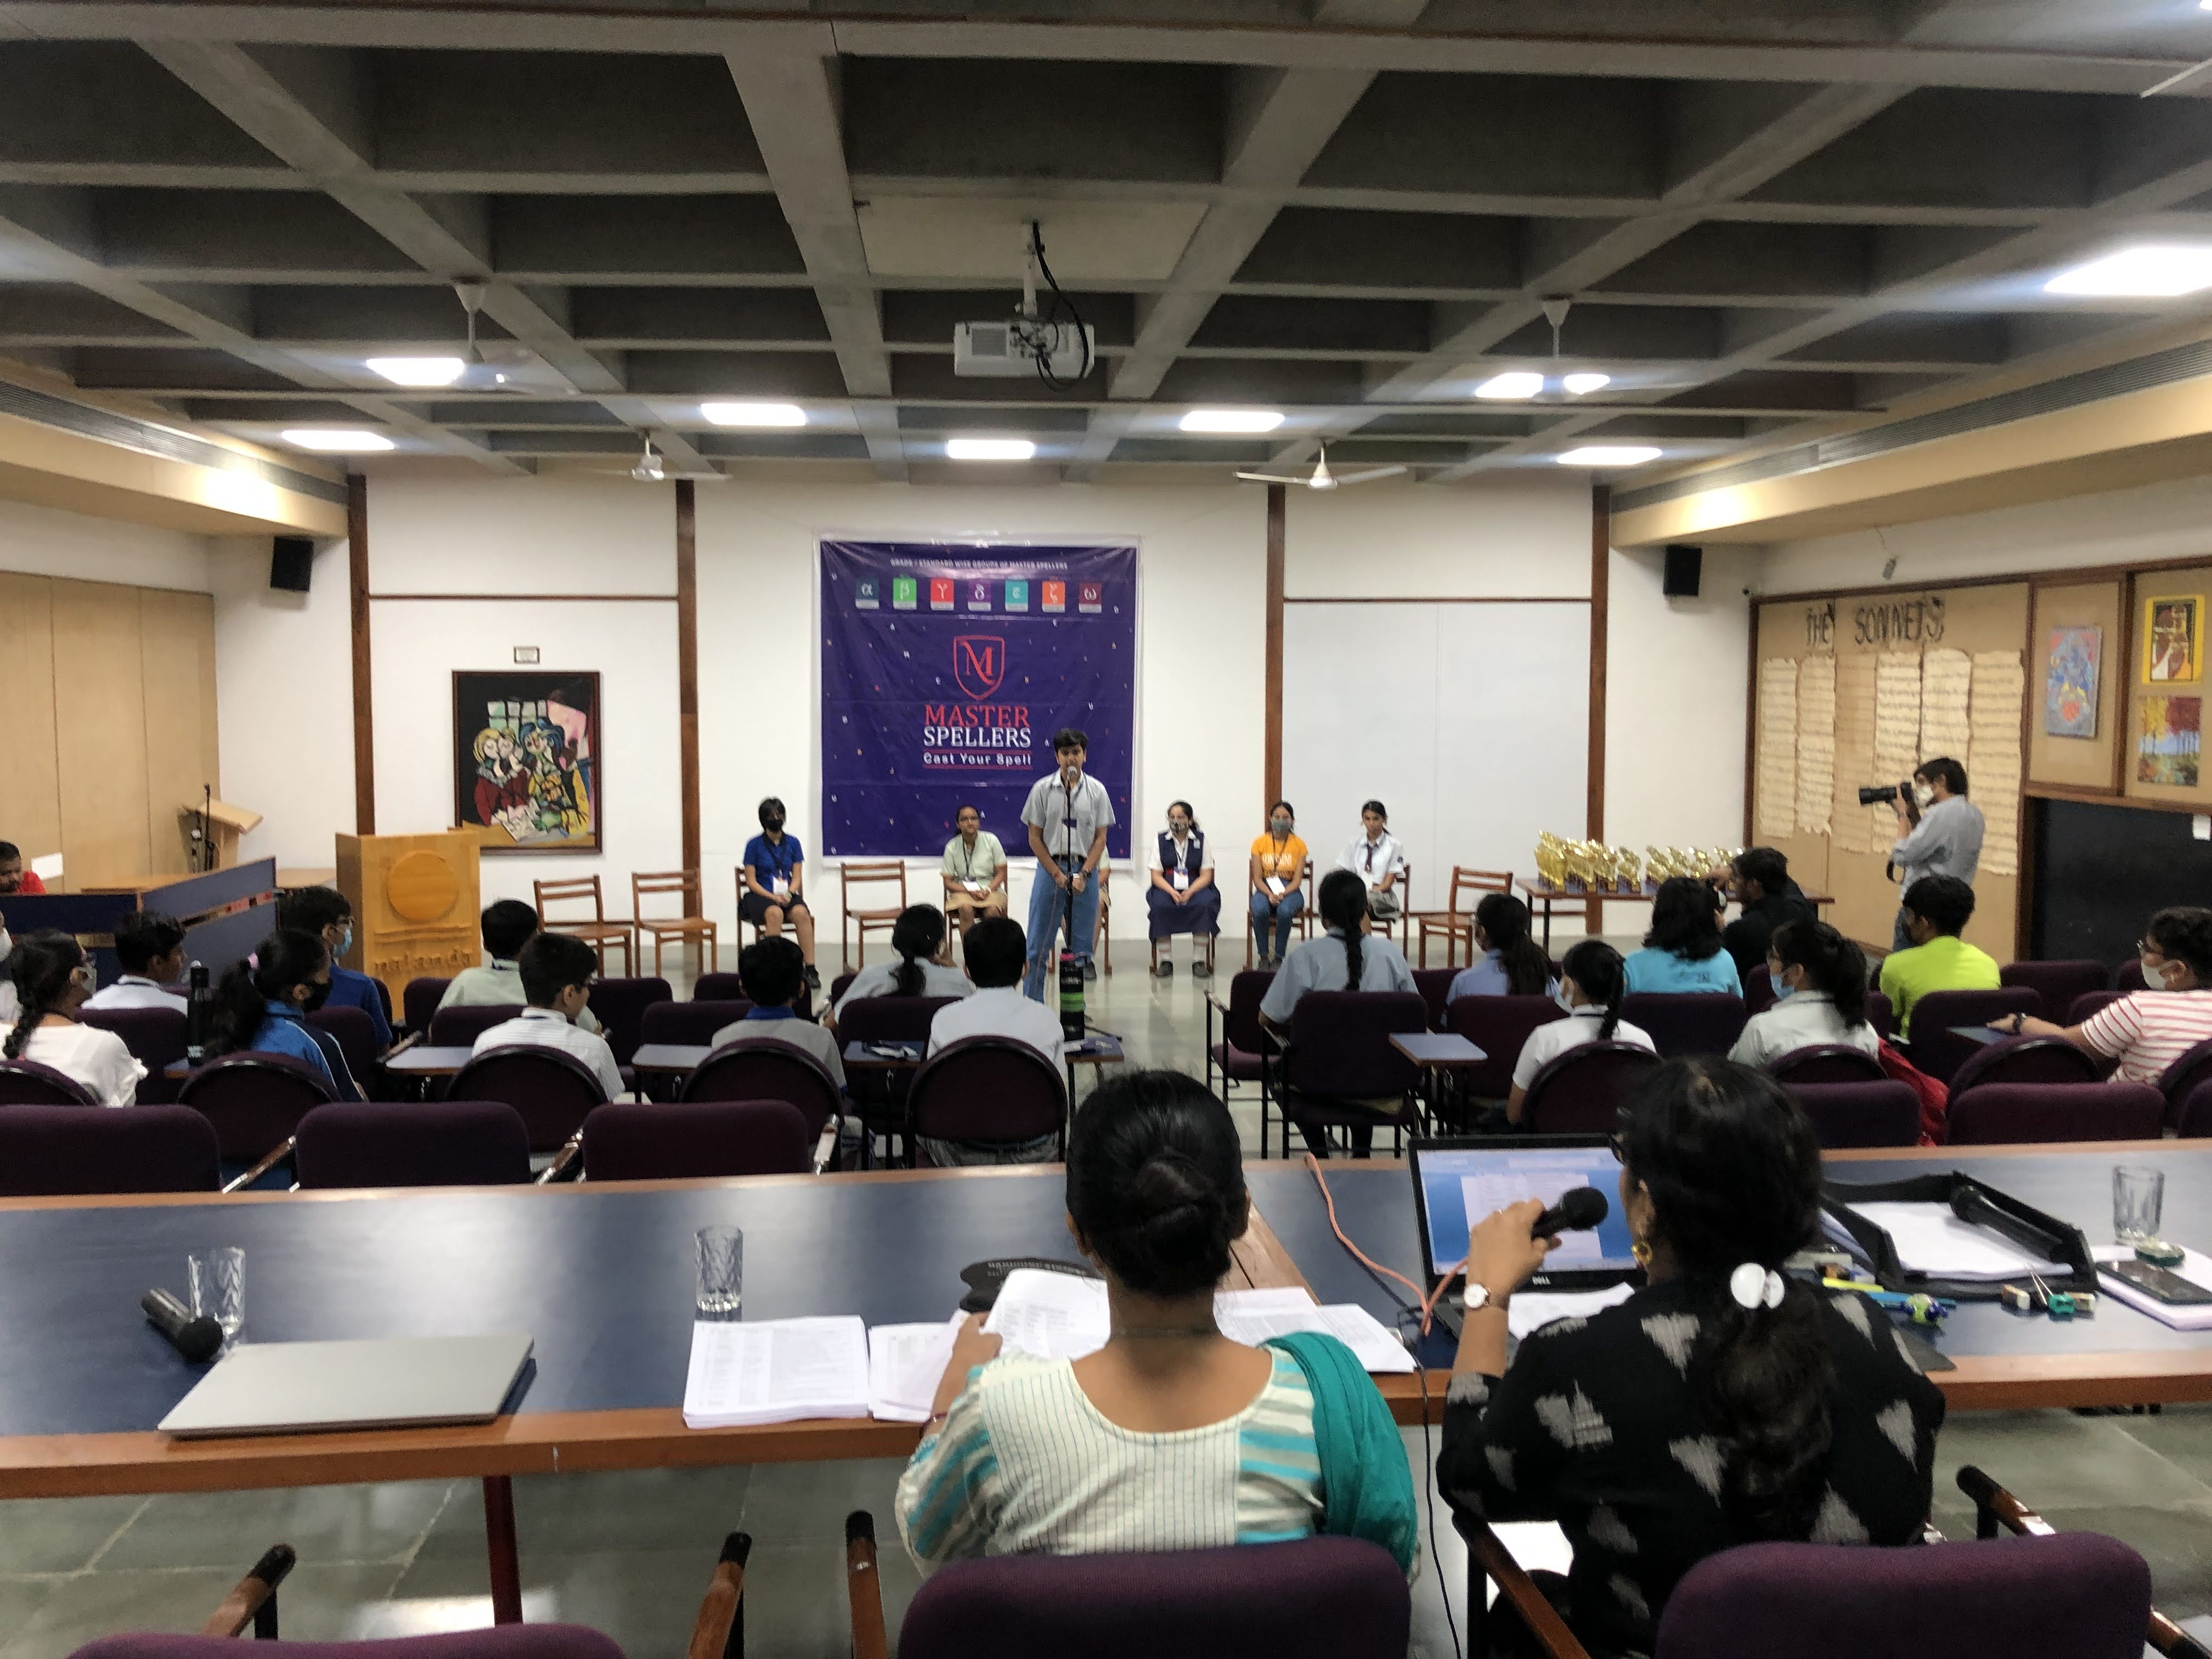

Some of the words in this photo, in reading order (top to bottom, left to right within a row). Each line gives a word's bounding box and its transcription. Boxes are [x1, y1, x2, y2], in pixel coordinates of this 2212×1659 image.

[924, 704, 1030, 728] MASTER
[923, 726, 1031, 748] SPELLERS
[923, 752, 955, 765] Cast
[960, 752, 991, 765] Your
[996, 753, 1031, 768] Spell
